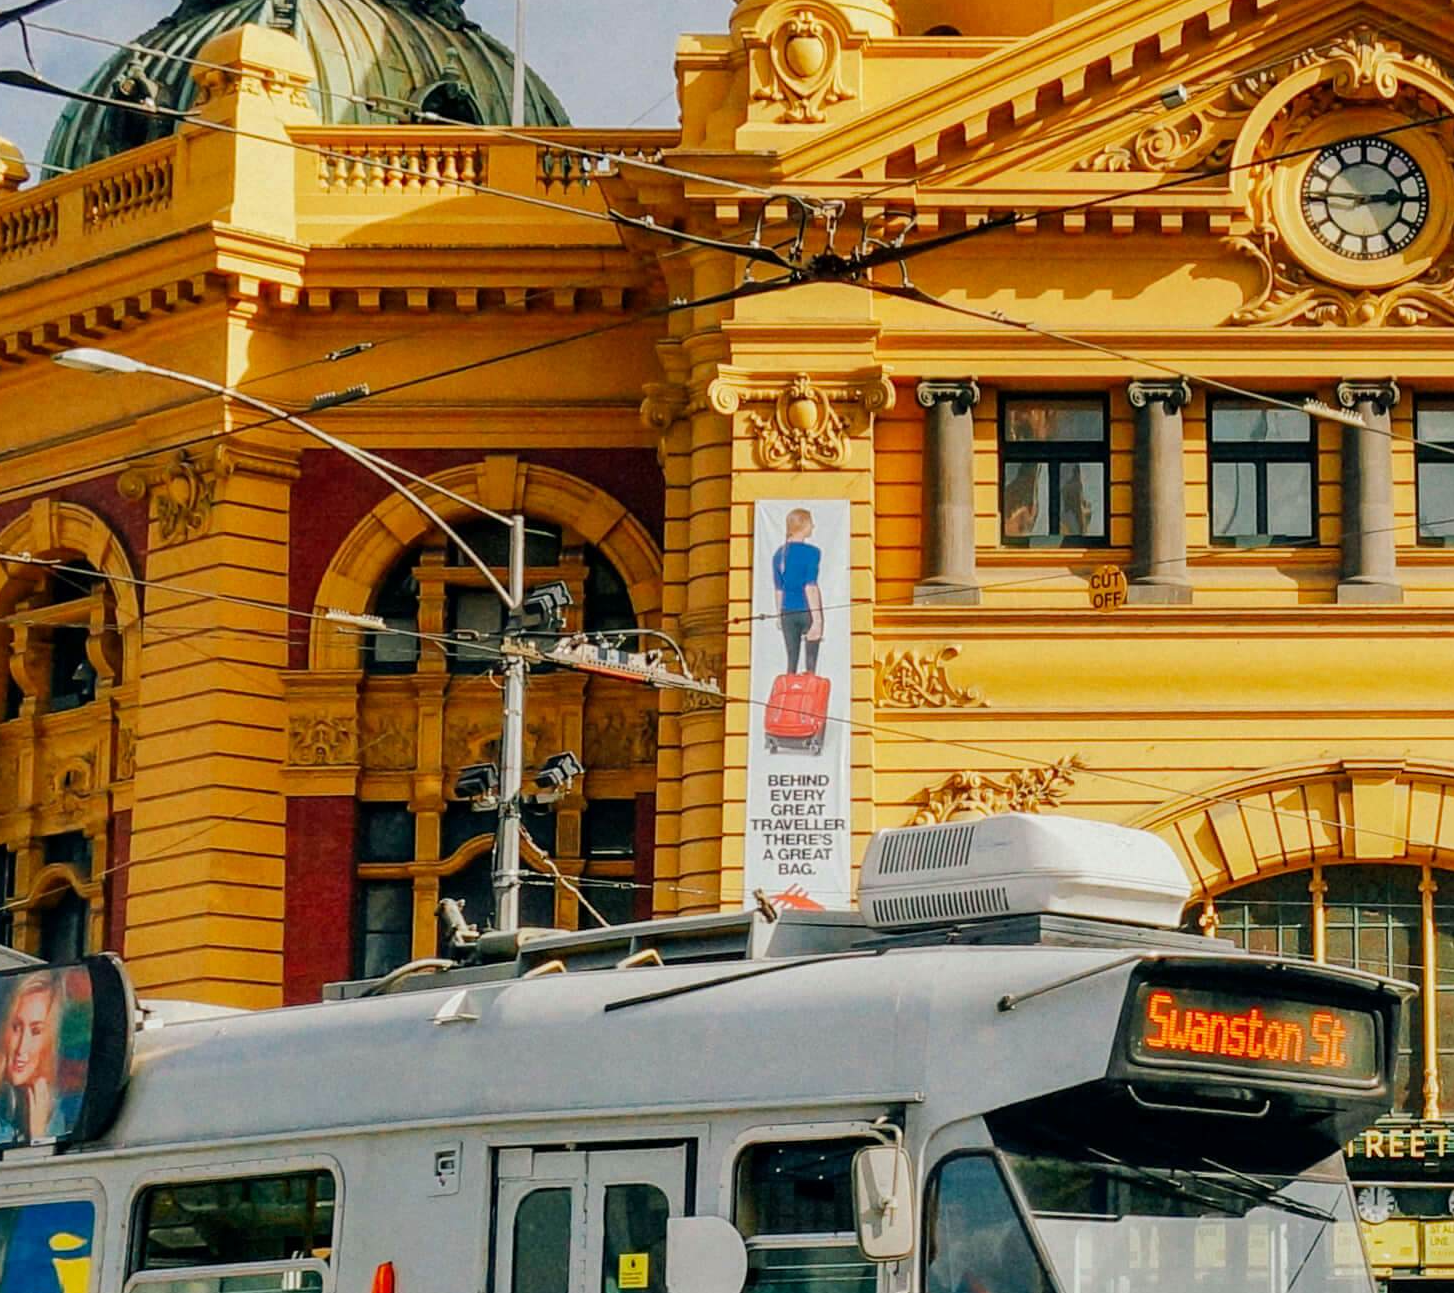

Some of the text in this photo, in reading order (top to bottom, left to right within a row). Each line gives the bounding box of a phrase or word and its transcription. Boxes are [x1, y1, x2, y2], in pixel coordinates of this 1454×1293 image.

[1091, 571, 1121, 589] CUT
[1093, 591, 1122, 608] OFF
[768, 774, 830, 787] BEHIND
[770, 789, 825, 801] EVERY
[770, 804, 826, 816] GREAT
[750, 819, 845, 831] TRAVELLER
[763, 833, 833, 845] THERE'S
[763, 848, 833, 860] A GREAT
[778, 863, 817, 875] BAG.
[1147, 992, 1347, 1066] Swanston St
[1347, 1128, 1450, 1158] REET
